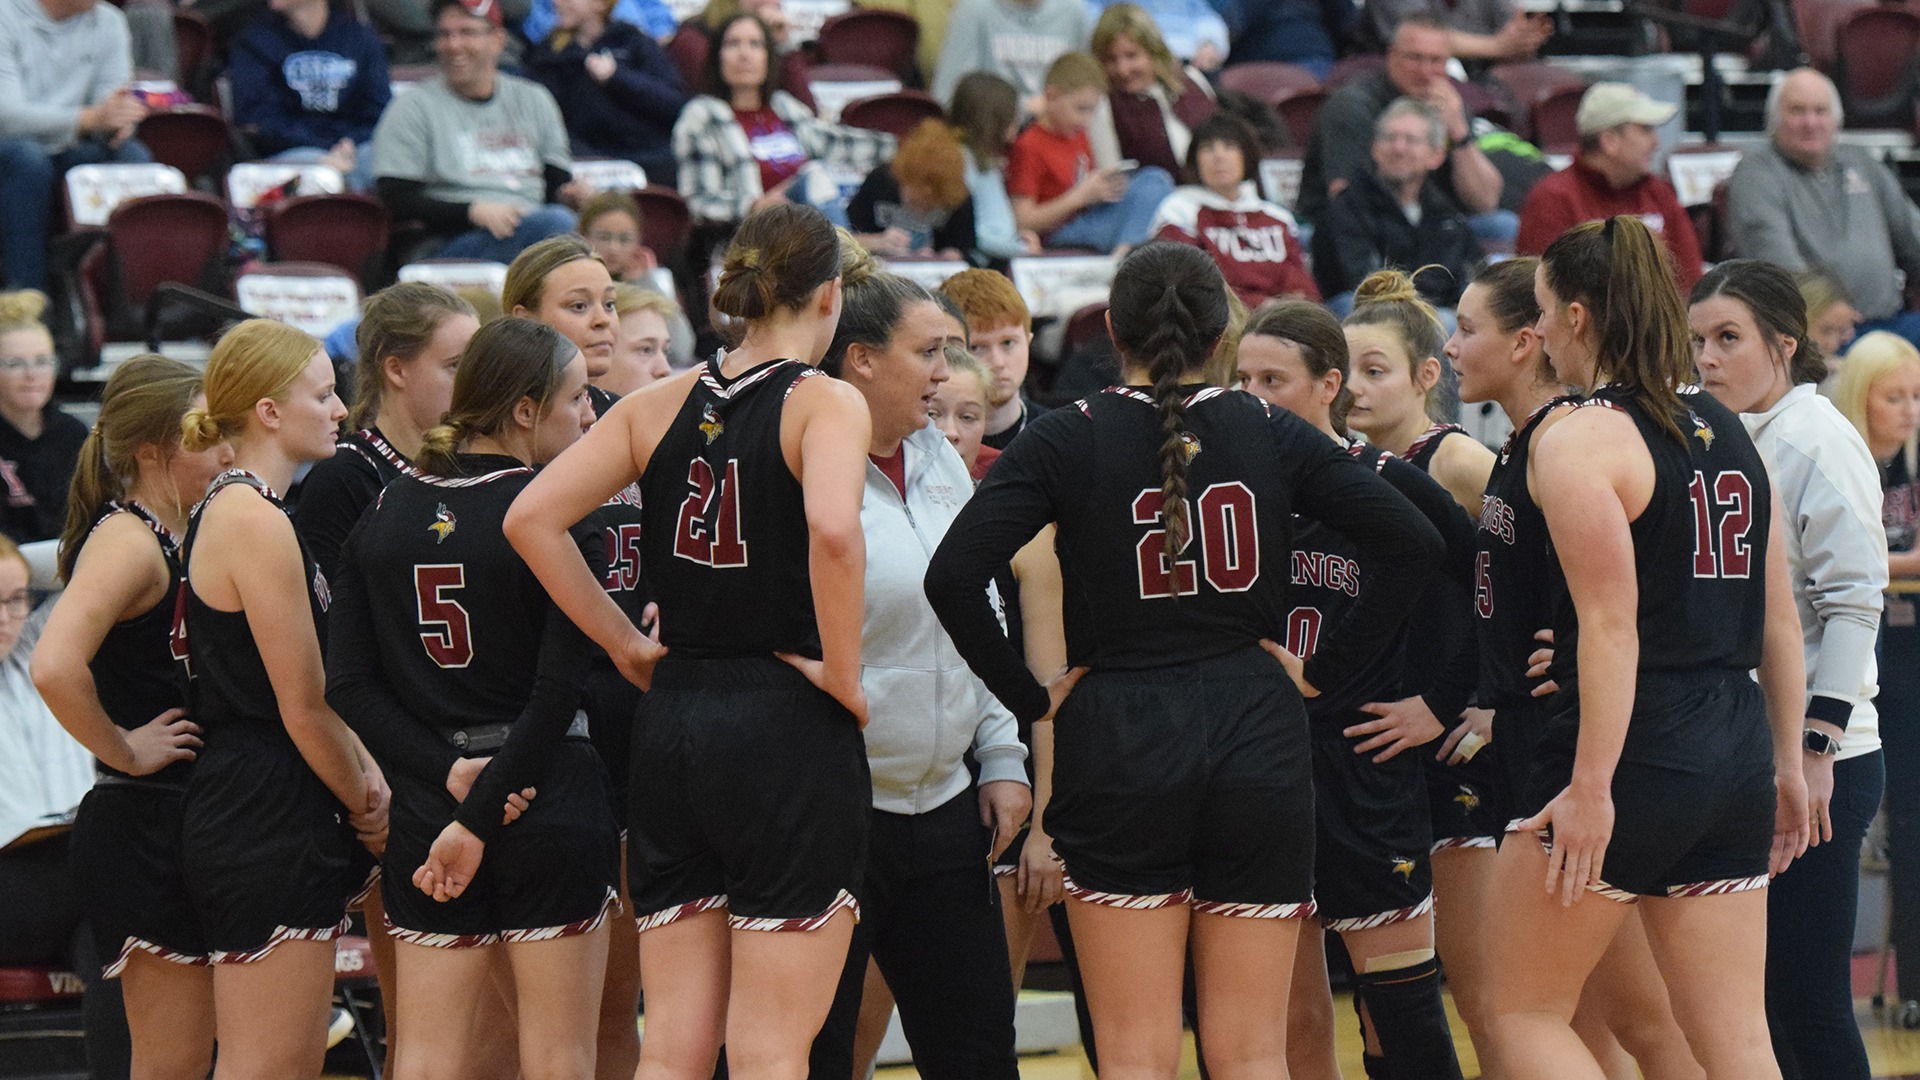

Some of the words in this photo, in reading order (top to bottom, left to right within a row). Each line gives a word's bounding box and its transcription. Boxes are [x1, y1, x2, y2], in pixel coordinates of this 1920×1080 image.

[1203, 225, 1287, 263] VCSU
[605, 524, 641, 592] 25
[673, 456, 748, 568] 21
[1131, 481, 1260, 599] 20
[1689, 470, 1752, 579] 12
[414, 564, 474, 668] 5
